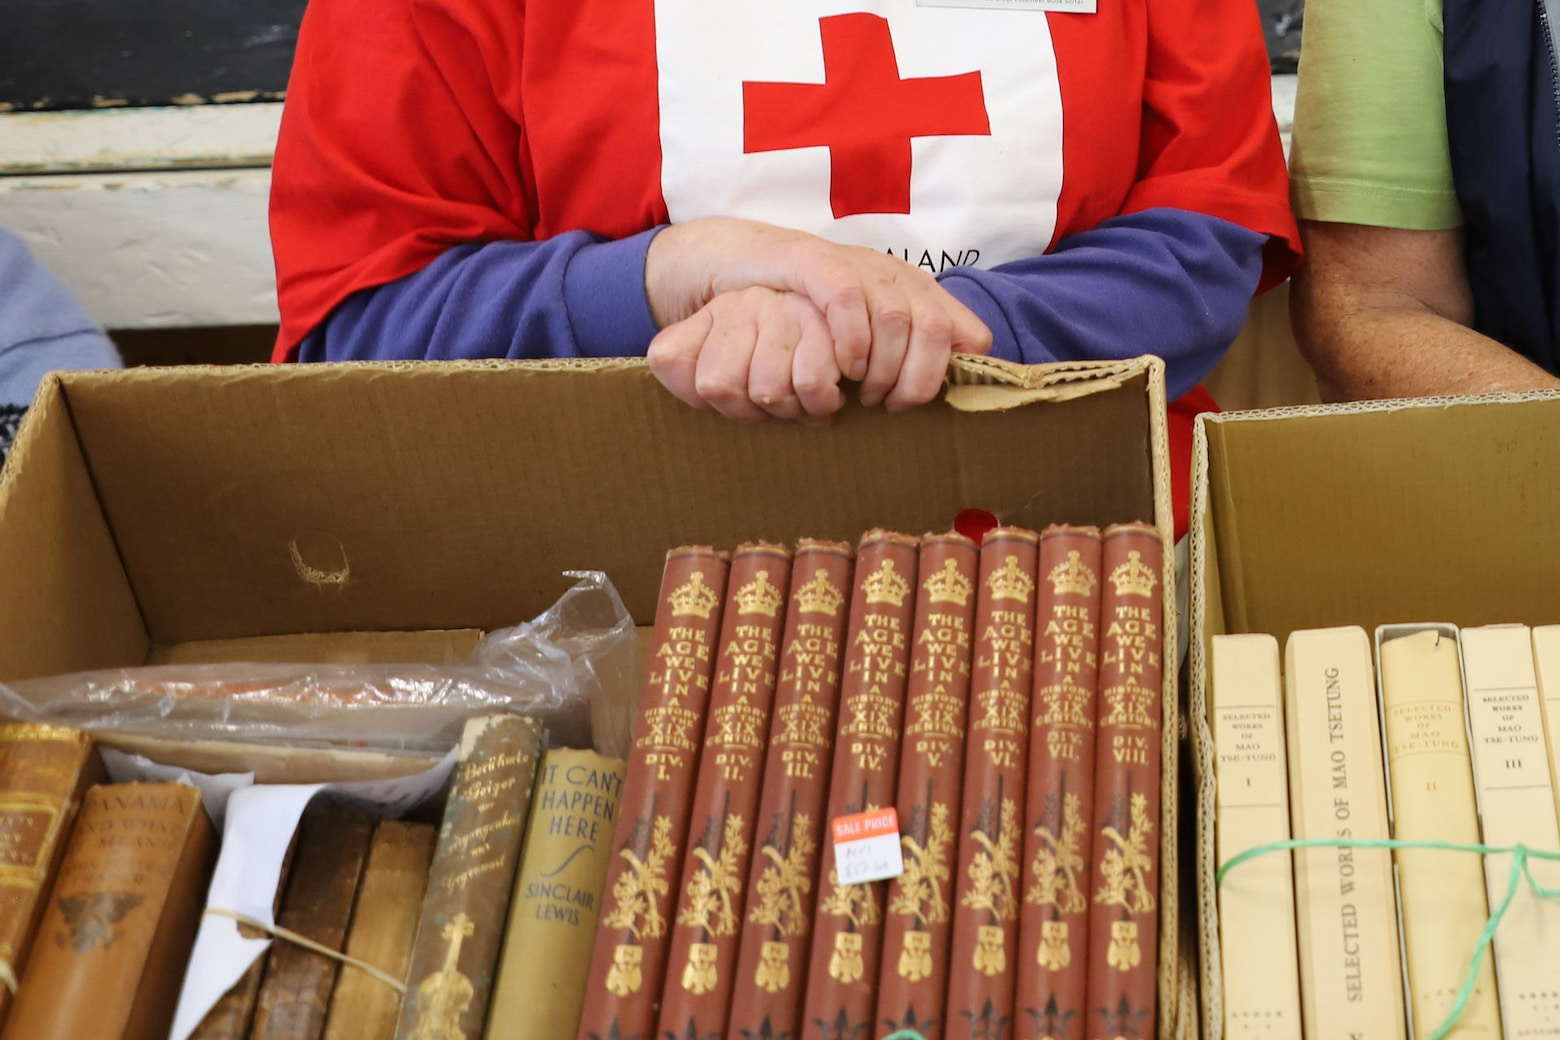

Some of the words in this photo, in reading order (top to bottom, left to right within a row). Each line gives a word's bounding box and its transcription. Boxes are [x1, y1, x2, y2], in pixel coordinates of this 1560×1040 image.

[1053, 605, 1088, 620] THE
[1115, 606, 1150, 621] THE
[865, 614, 900, 630] THE
[1044, 619, 1094, 639] AGE
[669, 627, 705, 643] THE
[1106, 620, 1156, 640] AGE
[855, 629, 904, 649] AGE
[1054, 634, 1082, 647] WE
[1116, 635, 1146, 648] WE
[656, 641, 709, 661] AGE
[863, 643, 892, 656] WE
[665, 656, 695, 669] WE
[1041, 647, 1096, 668] LIVE
[1103, 648, 1158, 669] LIVE
[1056, 661, 1080, 673] IN
[1119, 662, 1143, 675] IN
[1063, 675, 1073, 684] A
[1126, 676, 1137, 686] A
[1104, 686, 1156, 698] HISTORY
[1114, 702, 1147, 714] XIX
[1325, 667, 1344, 742] TSETUNG
[851, 742, 887, 757] DIV.
[916, 741, 952, 753] DIV.
[984, 740, 1020, 754] DIV.
[1113, 736, 1148, 749] DIV.
[645, 753, 683, 767] DIV.
[715, 754, 752, 767] DIV.
[782, 751, 819, 764] DIV.
[991, 751, 1016, 768] VI.
[1113, 749, 1149, 766] VIII.
[1506, 760, 1522, 768] III
[1331, 751, 1348, 789] MAO
[541, 765, 559, 784] IT
[566, 765, 623, 797] CAN'T
[542, 790, 615, 823] HAPPEN
[1334, 798, 1350, 820] OF
[549, 815, 599, 842] HERE
[525, 882, 594, 908] SINCLAIR
[536, 903, 580, 926] LEWIS
[1341, 903, 1363, 1003] SELECTED
